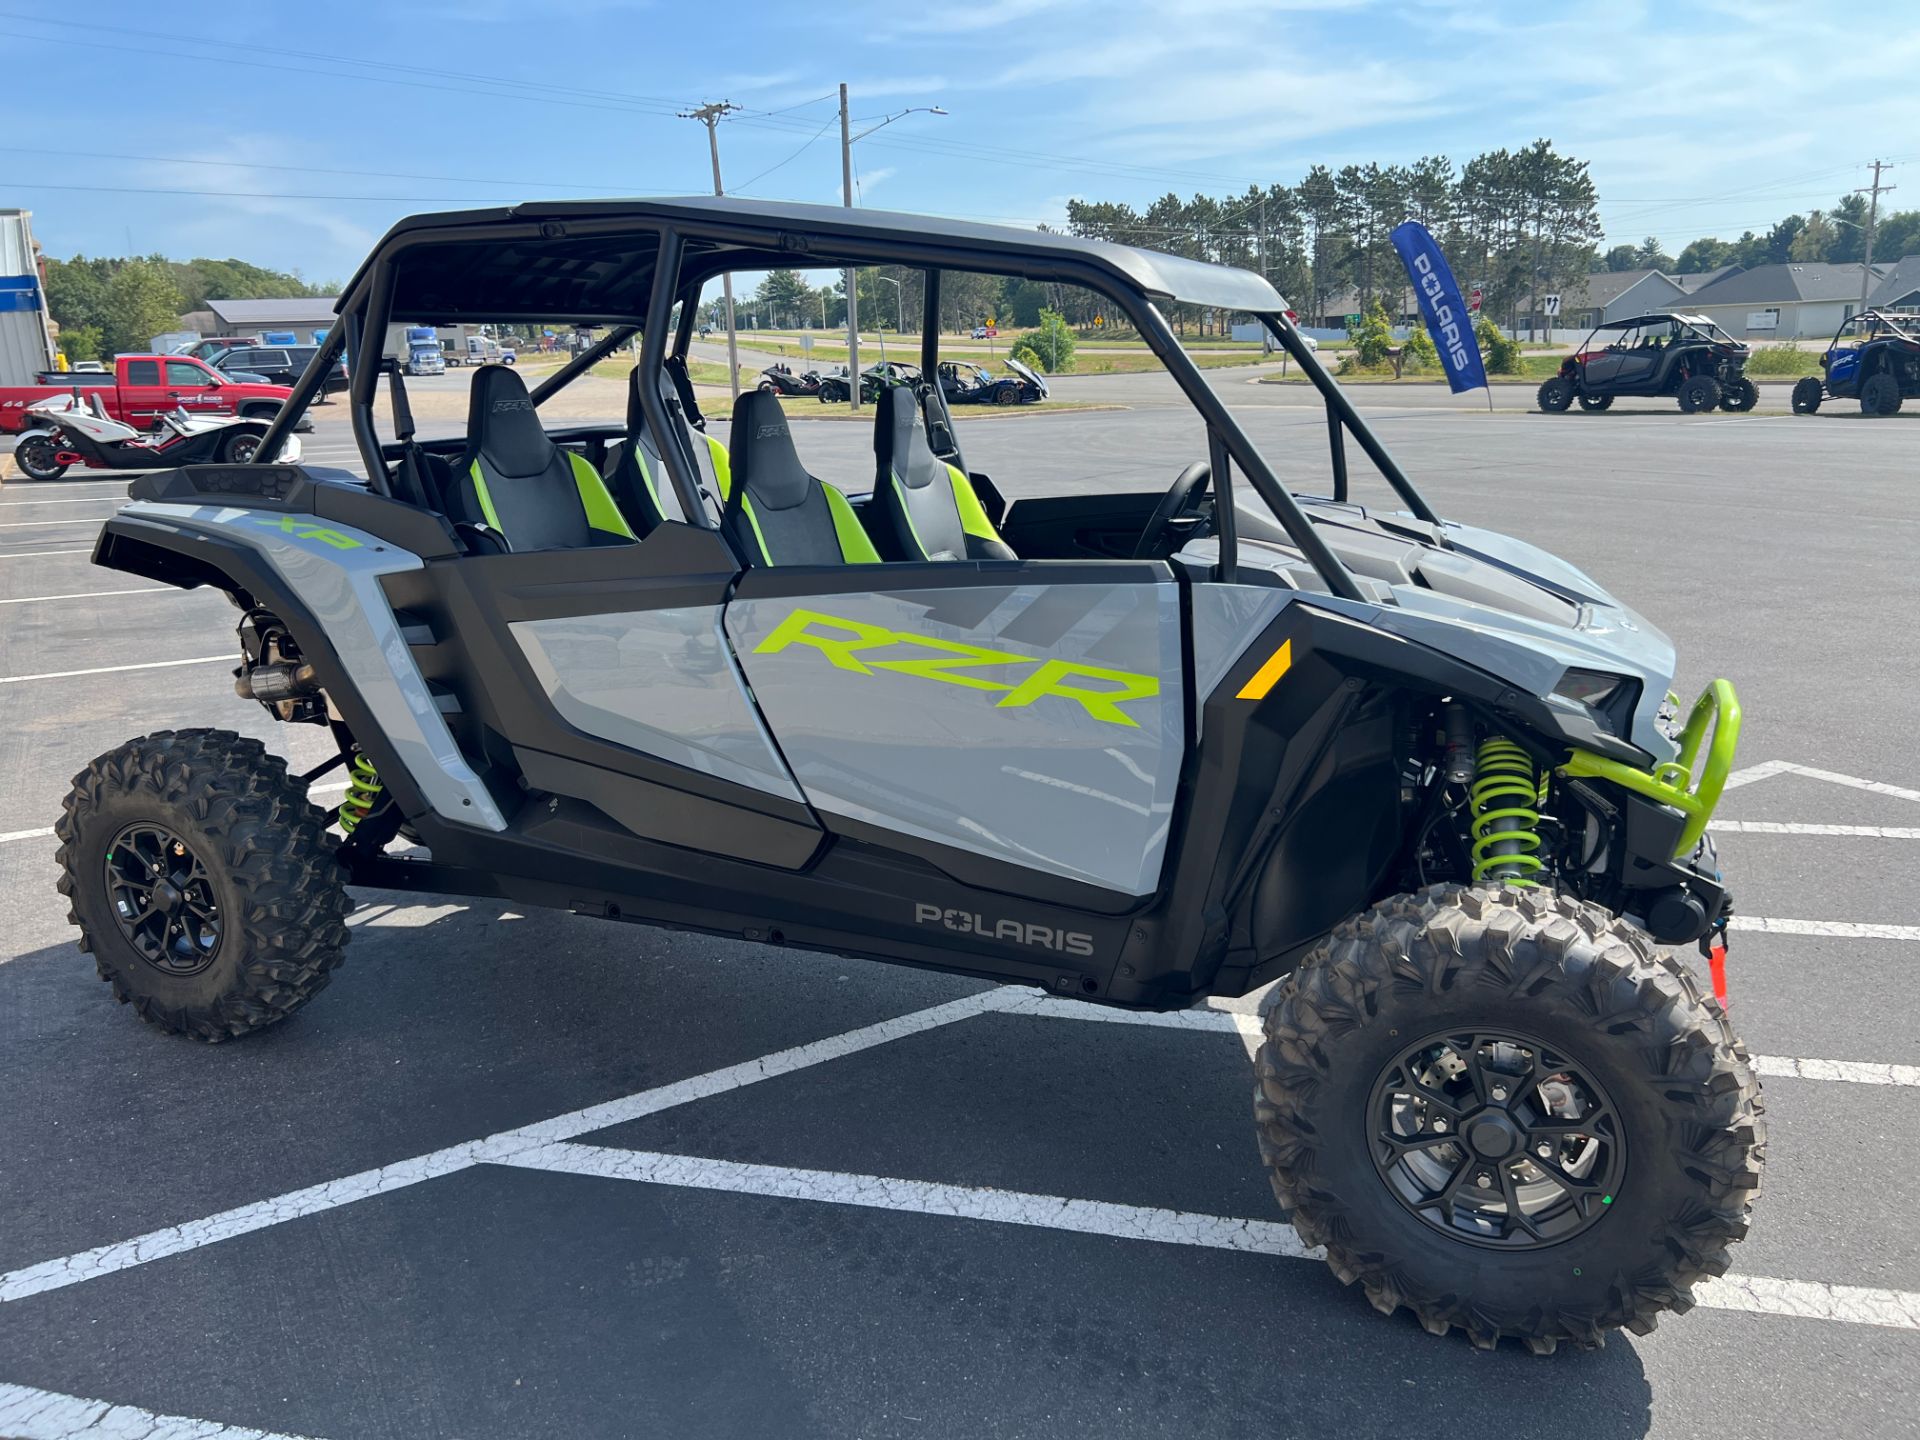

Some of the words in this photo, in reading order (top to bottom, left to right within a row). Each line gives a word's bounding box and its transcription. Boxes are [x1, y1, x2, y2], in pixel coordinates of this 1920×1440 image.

[1414, 253, 1469, 371] POLARIS
[492, 400, 532, 413] RZR
[254, 516, 365, 550] XP
[752, 608, 1160, 728] RZR
[915, 903, 1094, 956] POLARIS
